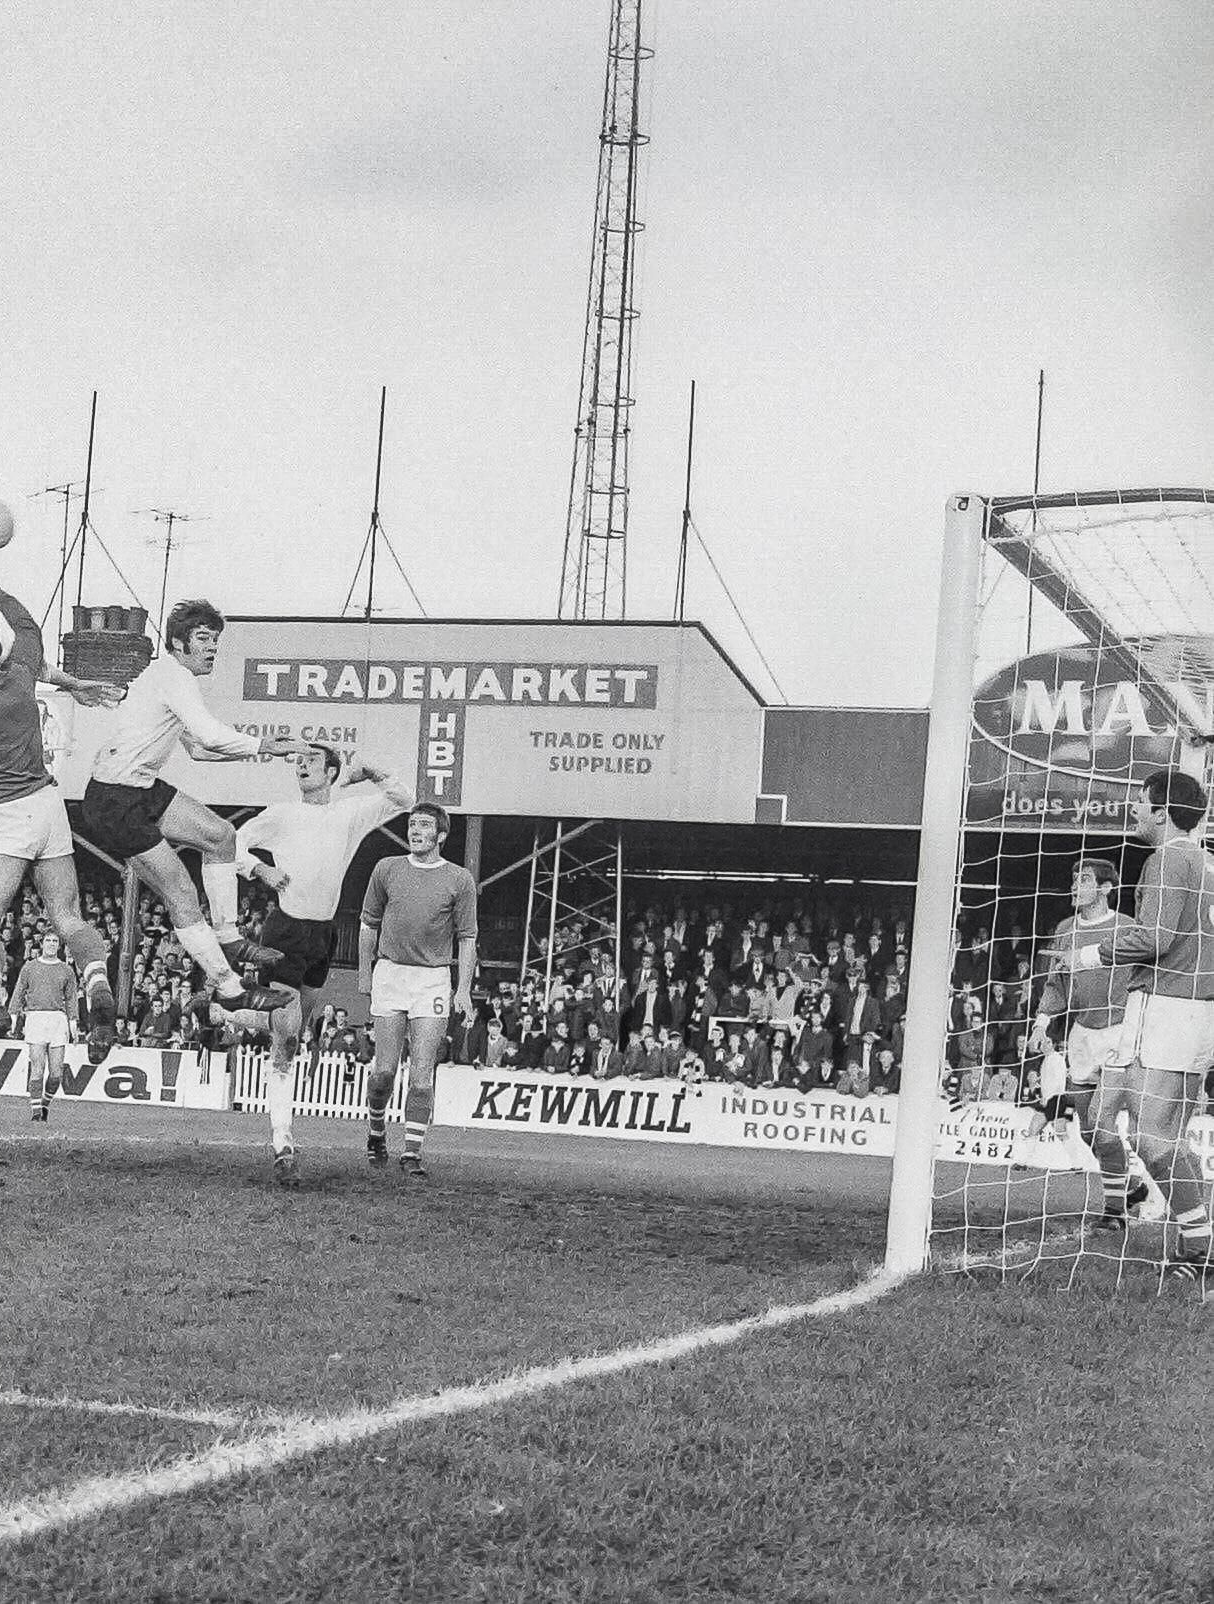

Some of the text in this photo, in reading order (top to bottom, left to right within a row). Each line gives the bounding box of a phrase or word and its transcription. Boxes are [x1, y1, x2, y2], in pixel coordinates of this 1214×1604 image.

[256, 664, 648, 703] TRADEMARKET
[301, 726, 357, 743] CASH
[530, 731, 666, 750] TRADE ONLY
[549, 756, 653, 774] SUPPLIED
[1003, 790, 1063, 814] does
[433, 996, 444, 1015] 6
[471, 1080, 691, 1134] KEWMILL
[720, 1096, 892, 1125] INDUSTRIAL
[742, 1121, 868, 1146] ROOFING
[954, 1140, 1013, 1159] 2482
